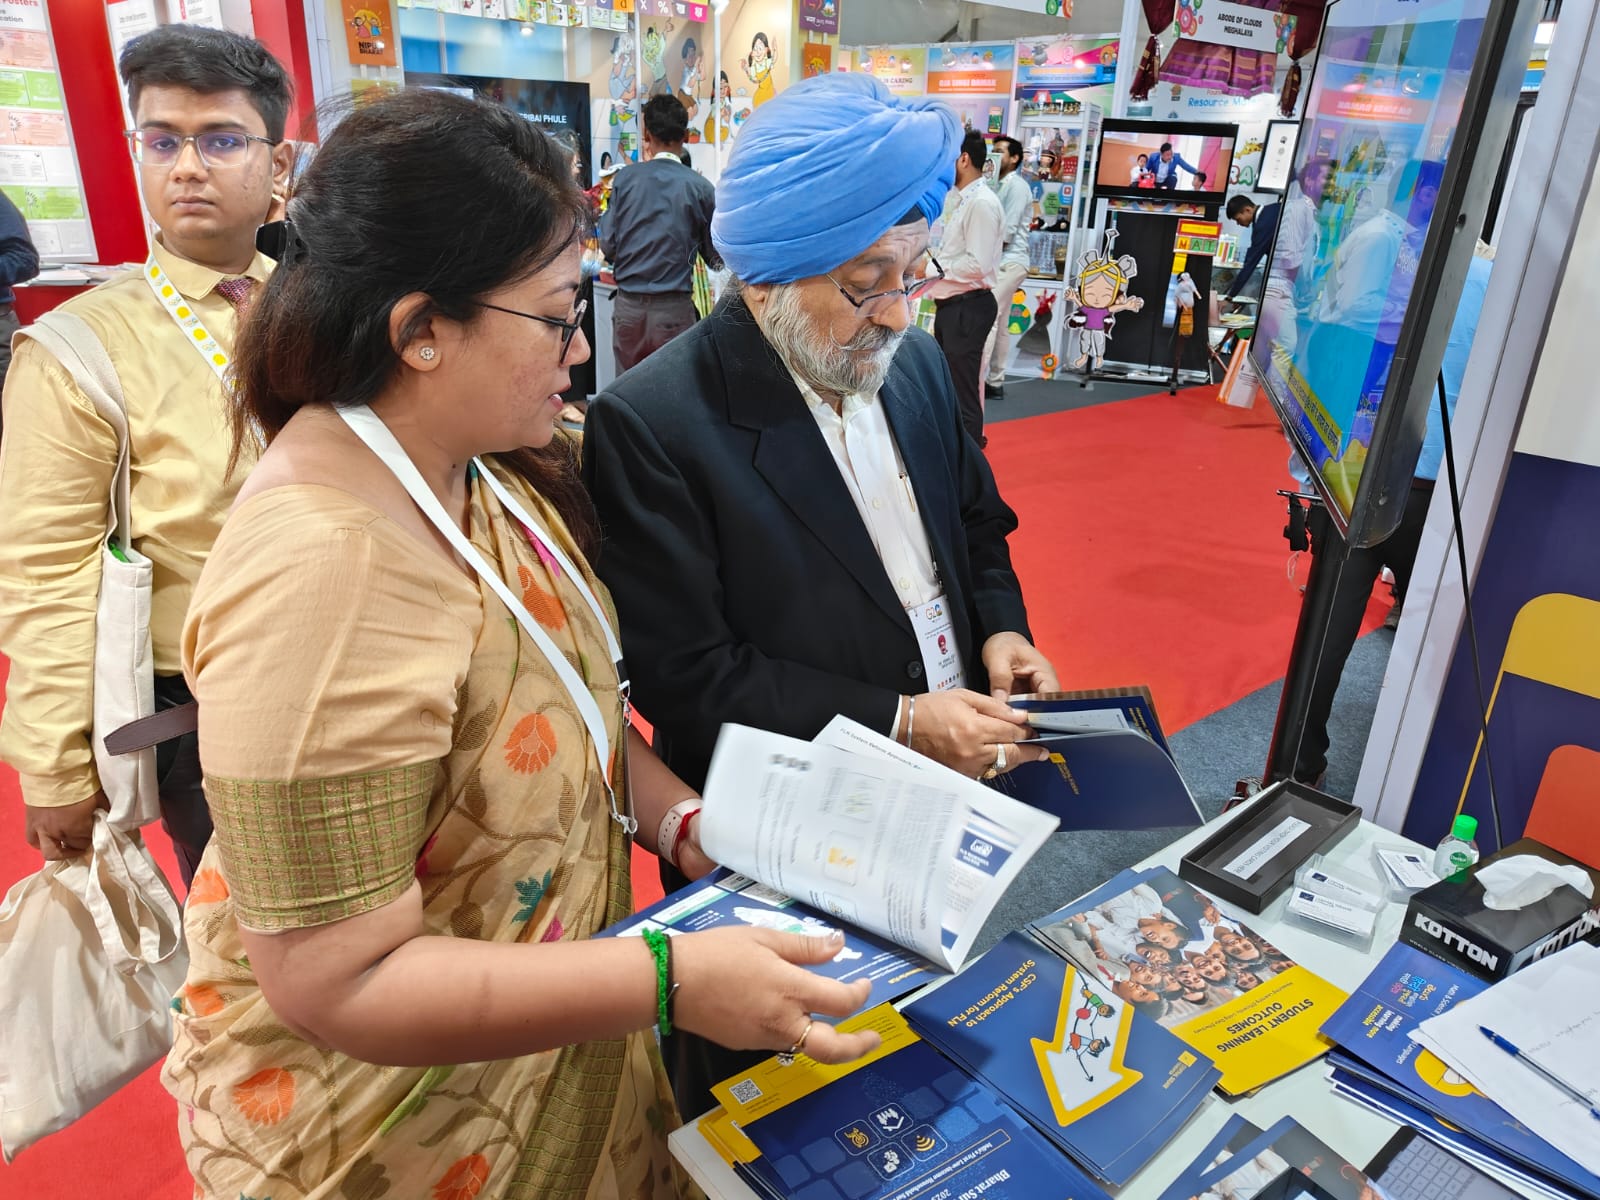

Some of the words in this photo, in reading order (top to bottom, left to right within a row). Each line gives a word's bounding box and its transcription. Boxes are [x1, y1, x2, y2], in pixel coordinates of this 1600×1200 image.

[1218, 13, 1235, 23] ABODE
[1236, 16, 1243, 24] OF
[1243, 18, 1263, 28] CLOUDS
[1224, 26, 1253, 37] MEGHALAYA
[542, 113, 567, 123] PHULE
[1415, 912, 1498, 971] KOTTON
[1002, 956, 1037, 987] System
[1010, 970, 1038, 996] CSF's
[974, 988, 1015, 1024] Approach
[975, 981, 1008, 1009] Reform
[945, 1009, 967, 1030] FLN
[963, 1002, 979, 1018] for
[1225, 997, 1283, 1038] OUTCOMES
[1266, 995, 1314, 1029] STUDENT
[964, 1016, 978, 1030] to
[1214, 1019, 1268, 1057] LEARNING
[959, 1151, 977, 1163] First
[975, 1169, 1011, 1194] Bharat
